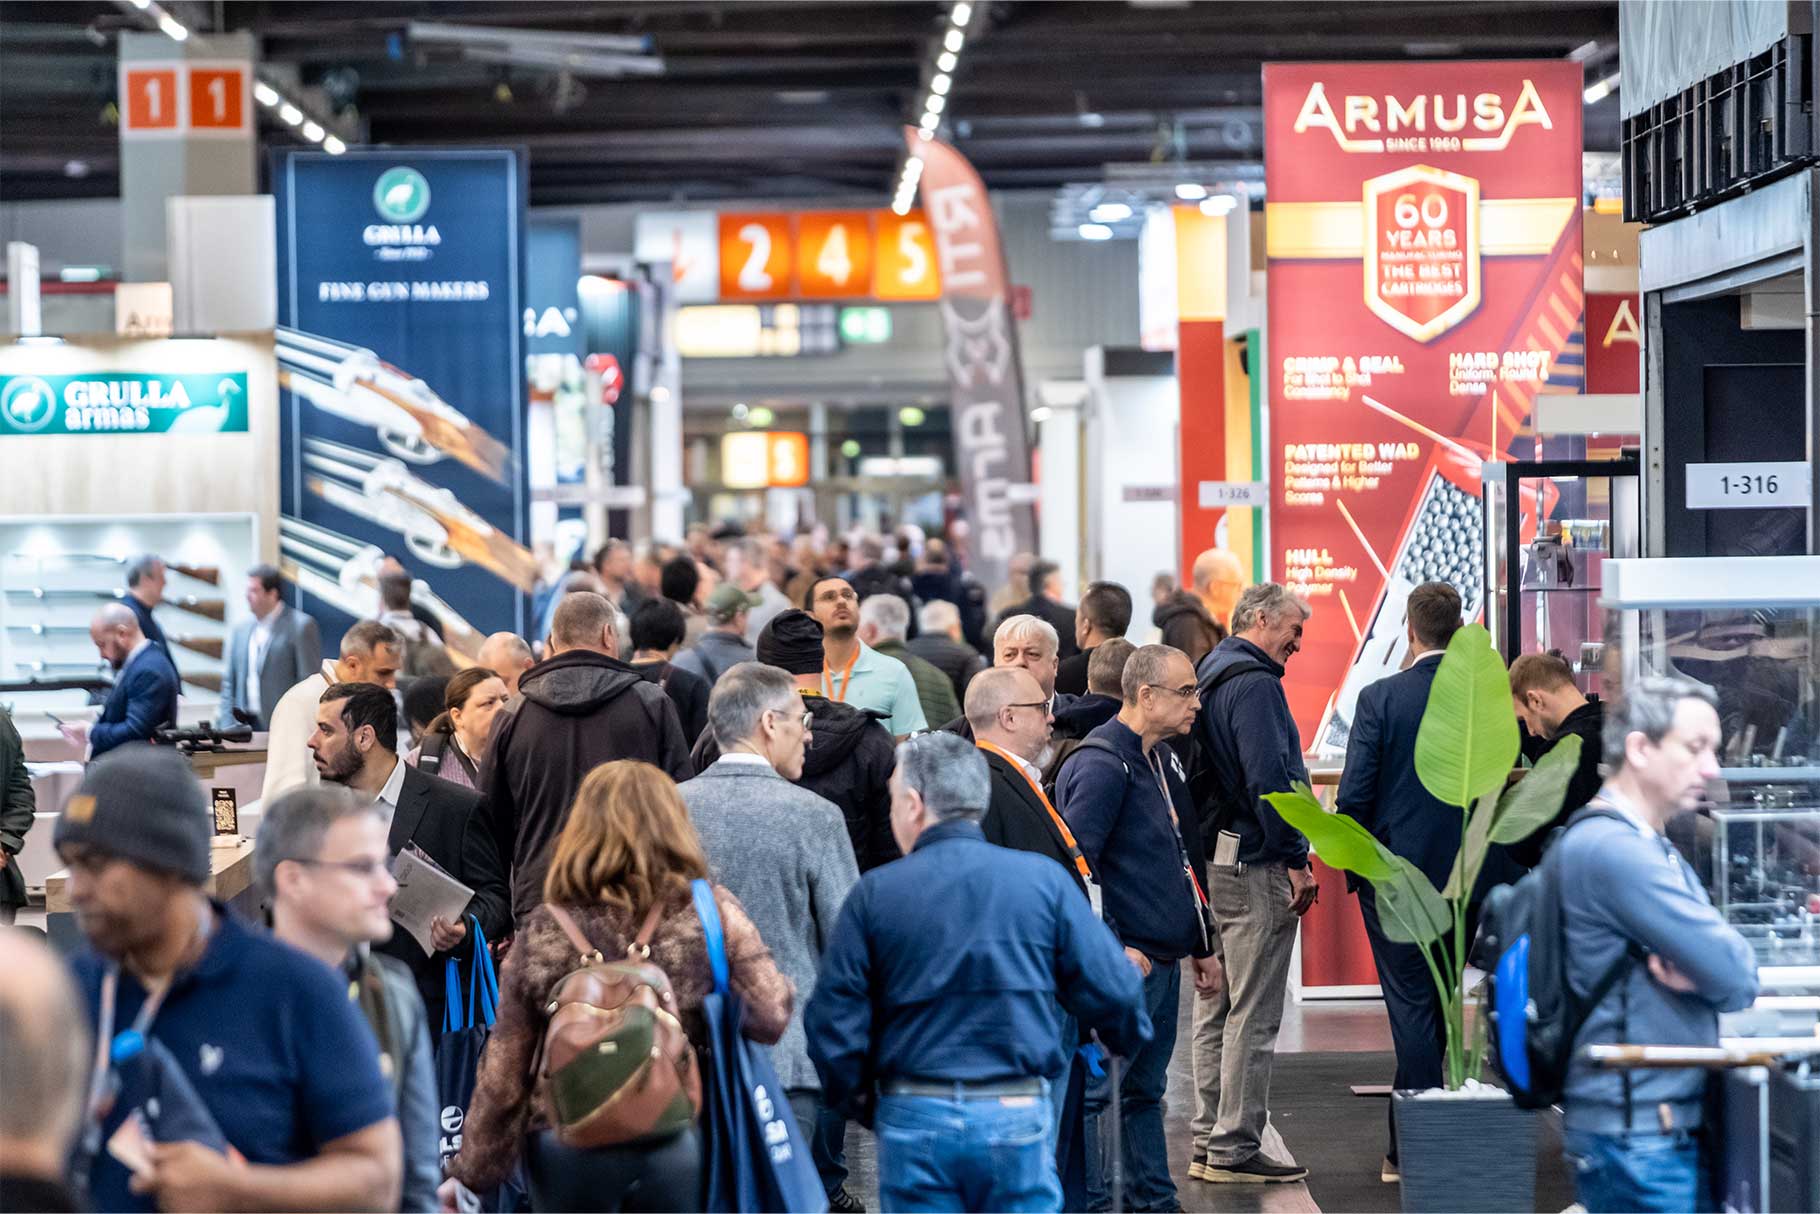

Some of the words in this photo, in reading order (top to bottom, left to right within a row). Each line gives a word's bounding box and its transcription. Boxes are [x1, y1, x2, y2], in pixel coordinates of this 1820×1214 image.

[144, 78, 160, 121] 1
[207, 77, 226, 122] 1
[1293, 79, 1553, 145] ARMUSA
[1386, 136, 1427, 152] SINCE
[1394, 193, 1448, 229] 60
[363, 225, 442, 246] GRULLA
[1386, 228, 1457, 250] YEARS
[738, 224, 773, 291] 2
[817, 224, 852, 287] 4
[899, 222, 928, 284] 5
[1382, 263, 1415, 279] THE
[1418, 262, 1462, 279] BEST
[318, 282, 366, 301] FINE
[367, 282, 409, 301] GUN
[411, 281, 490, 301] MAKERS
[1381, 281, 1463, 297] CARTRIDGES
[1449, 352, 1499, 370] HARD
[1502, 350, 1551, 369] SHOT
[64, 380, 191, 409] GRULLA
[65, 406, 150, 430] armas
[1284, 443, 1376, 461] PATENTED
[1378, 442, 1420, 460] WAD
[1284, 460, 1338, 476] Designed
[1340, 460, 1356, 475] for
[1358, 460, 1393, 475] Better
[1217, 487, 1250, 500] 1-326
[1342, 475, 1380, 492] Higher
[1720, 475, 1778, 495] 1-316
[1285, 548, 1334, 566] HULL
[1285, 566, 1313, 583] High
[1314, 566, 1358, 583] Density
[1286, 582, 1334, 599] Polymer
